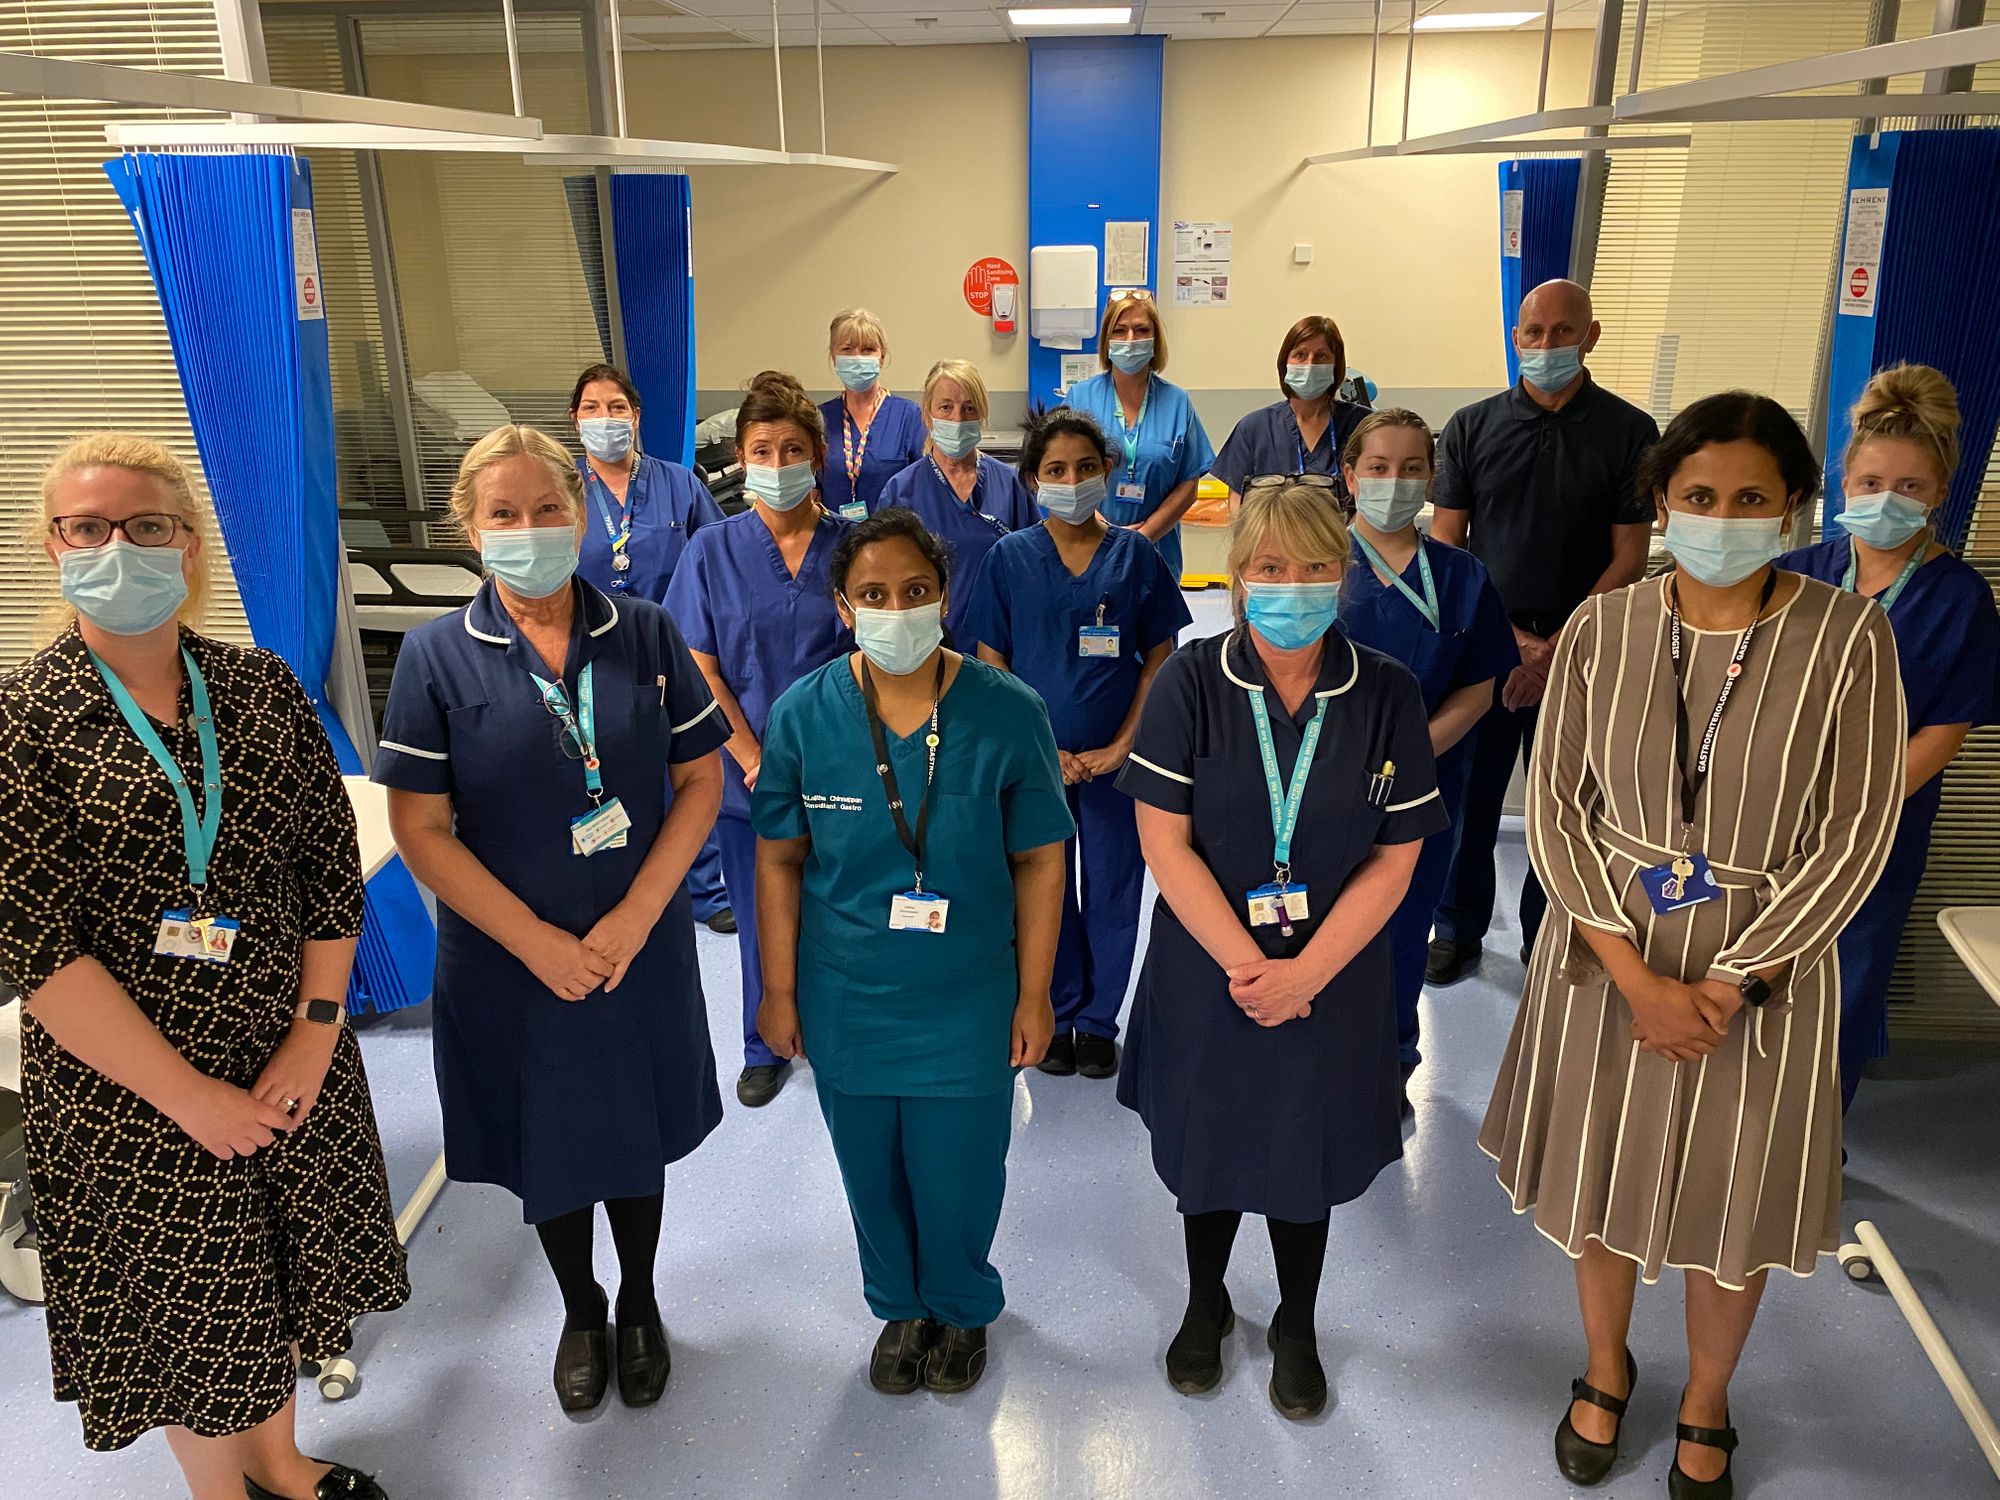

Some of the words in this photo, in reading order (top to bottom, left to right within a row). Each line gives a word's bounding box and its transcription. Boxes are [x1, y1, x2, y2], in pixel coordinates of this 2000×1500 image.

[1852, 196, 1886, 204] BEHRENS
[1258, 717, 1265, 728] We
[1698, 676, 1735, 773] GASTROENTEROLOGIST
[1308, 721, 1319, 739] NHS
[1263, 742, 1272, 760] WHH
[1304, 739, 1314, 755] WHH
[1265, 760, 1275, 778] NHS
[1301, 756, 1309, 768] are
[1297, 768, 1305, 780] We
[1271, 780, 1277, 792] We
[1291, 783, 1302, 801] NHS
[840, 803, 862, 811] Gastro
[1287, 801, 1296, 818] WHH
[1281, 831, 1289, 842] We
